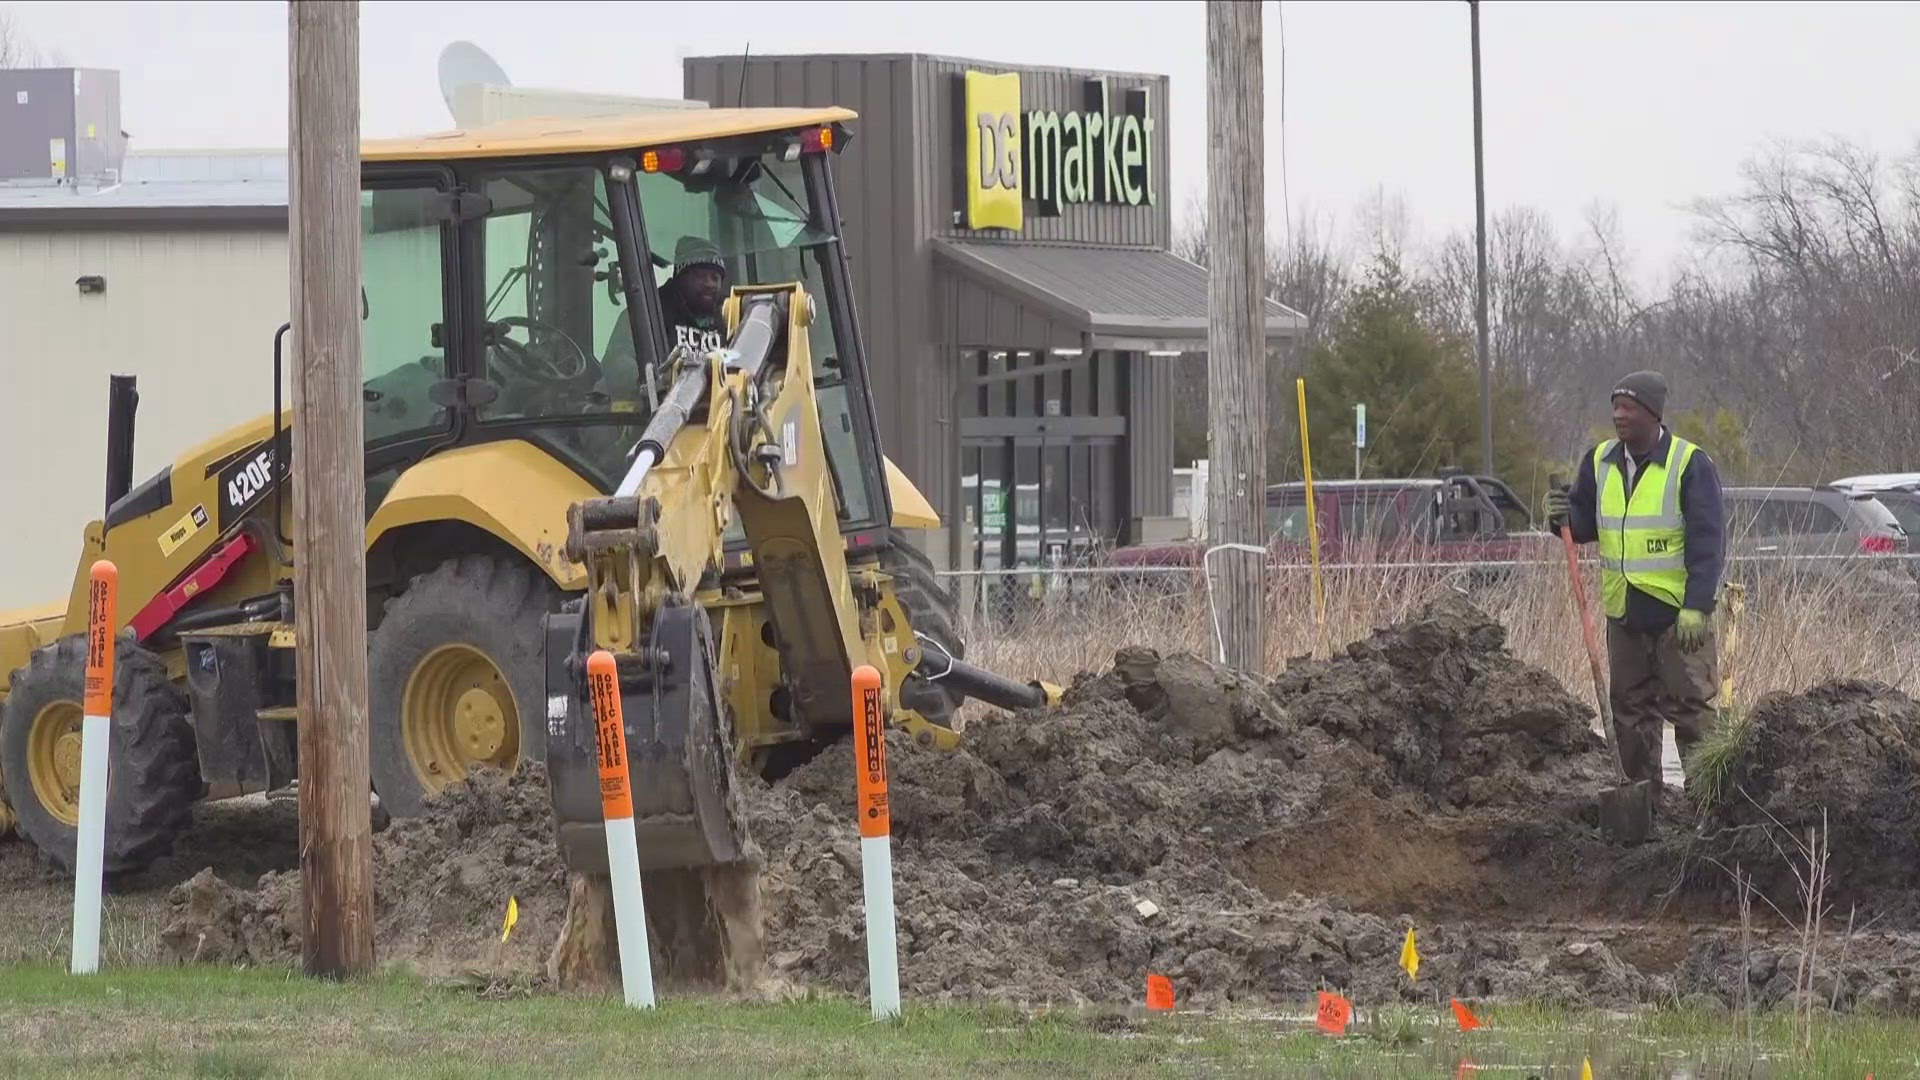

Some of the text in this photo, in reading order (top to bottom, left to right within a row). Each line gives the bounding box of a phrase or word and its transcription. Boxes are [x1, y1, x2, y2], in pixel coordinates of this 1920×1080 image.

[978, 75, 1156, 216] DG market
[228, 452, 272, 507] 420F
[1647, 539, 1668, 553] CAT
[99, 581, 107, 622] OPTIC
[596, 674, 608, 722] BURIED
[604, 673, 616, 718] OPTIC
[610, 723, 621, 766] CABLE
[865, 690, 878, 770] WARNING
